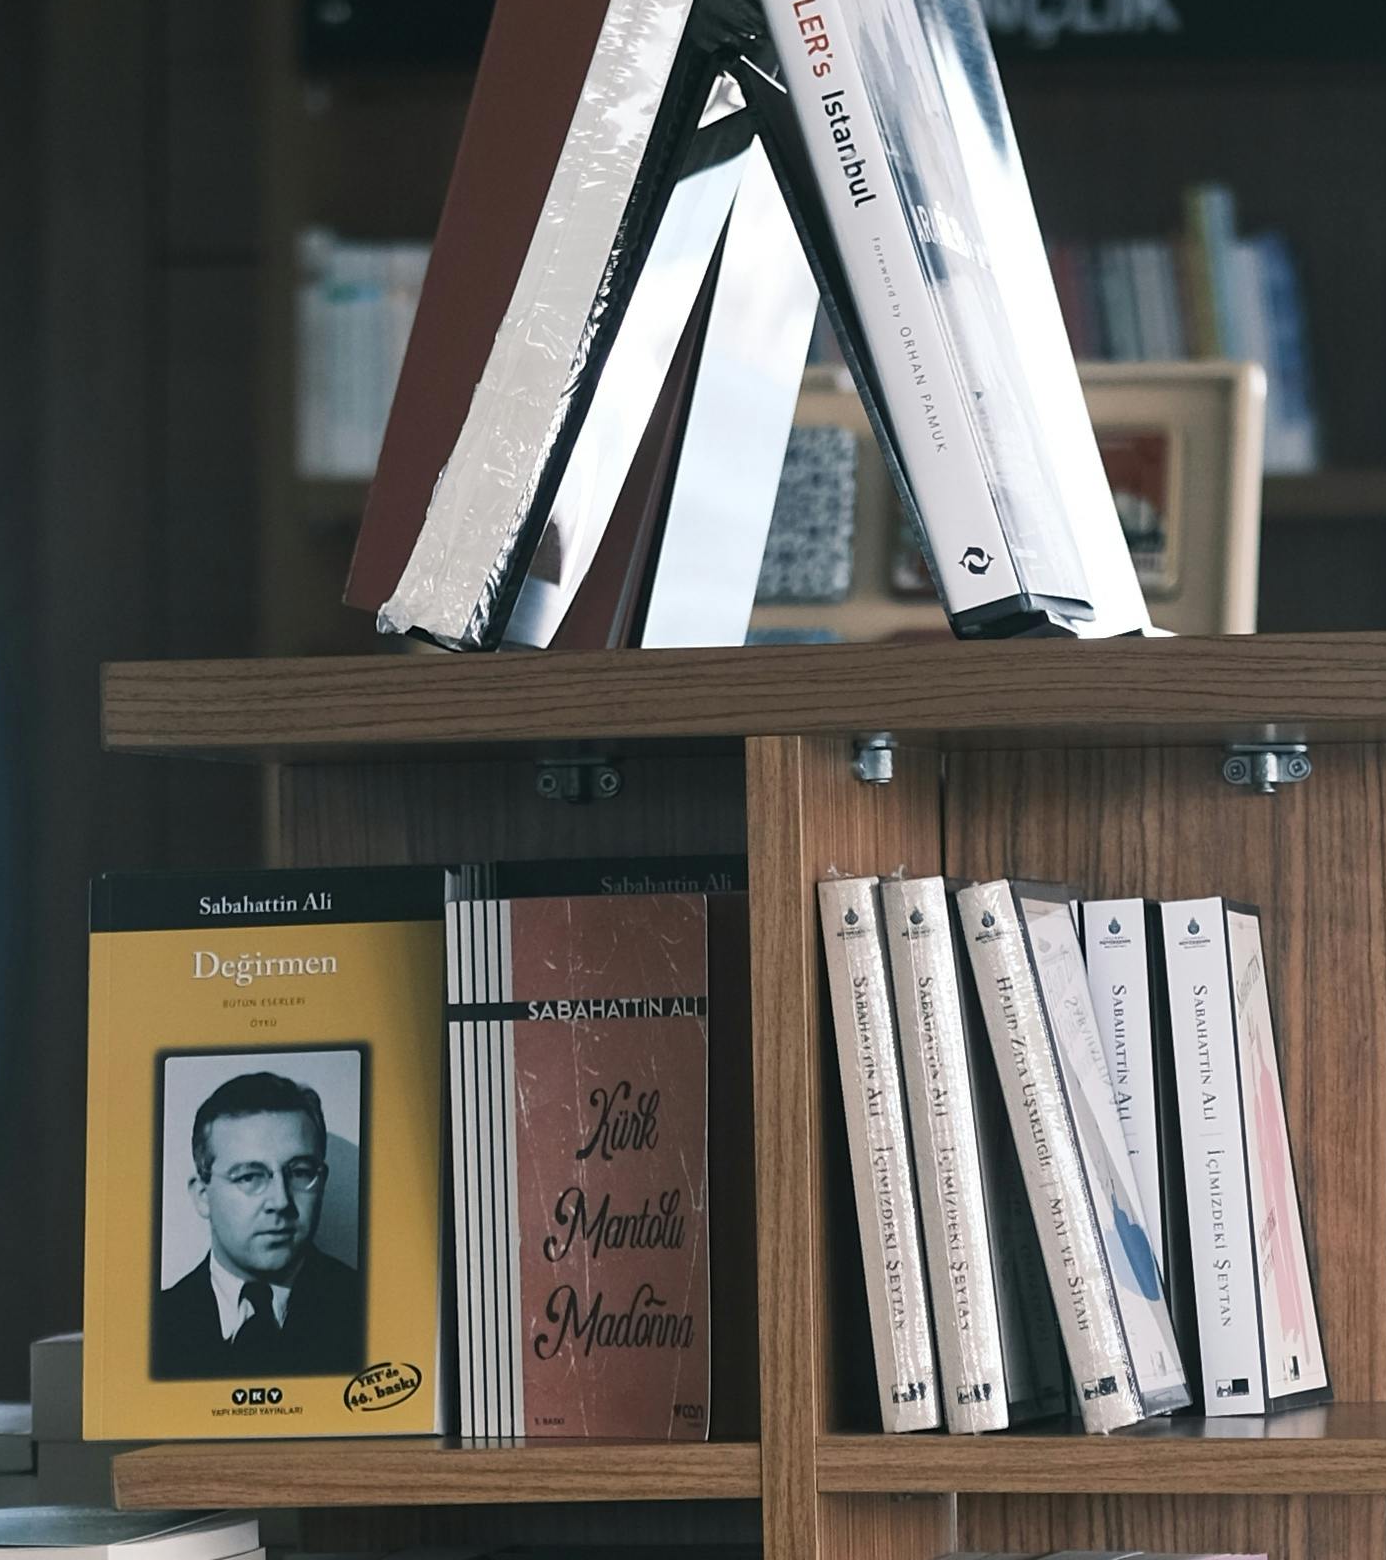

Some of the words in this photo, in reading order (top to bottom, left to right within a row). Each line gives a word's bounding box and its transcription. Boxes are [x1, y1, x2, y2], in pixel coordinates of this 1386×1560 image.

[820, 89, 878, 209] Istanbul
[892, 303, 902, 320] by
[900, 326, 928, 386] ORHAN
[921, 393, 948, 454] PAMUK
[199, 894, 297, 915] Sabahattin
[302, 892, 333, 912] Ali
[192, 950, 338, 987] Değirmen
[222, 997, 257, 1009] BÜTÜN
[261, 996, 306, 1007] ESERLERİ
[528, 997, 663, 1020] SABAHATTİN
[670, 996, 699, 1017] ALİ
[250, 1017, 278, 1028] ÖYKÜ
[576, 1081, 661, 1160] Kürk
[1193, 984, 1213, 1085] SABAHATTİN
[1212, 1259, 1232, 1327] ŞEYTAN
[543, 1187, 686, 1262] Mantolu
[534, 1284, 695, 1360] Madonna
[357, 1367, 400, 1388] YKY'de
[374, 1376, 416, 1399] baskı
[232, 1387, 283, 1405] YKY
[260, 1406, 303, 1415] YAYINLARI
